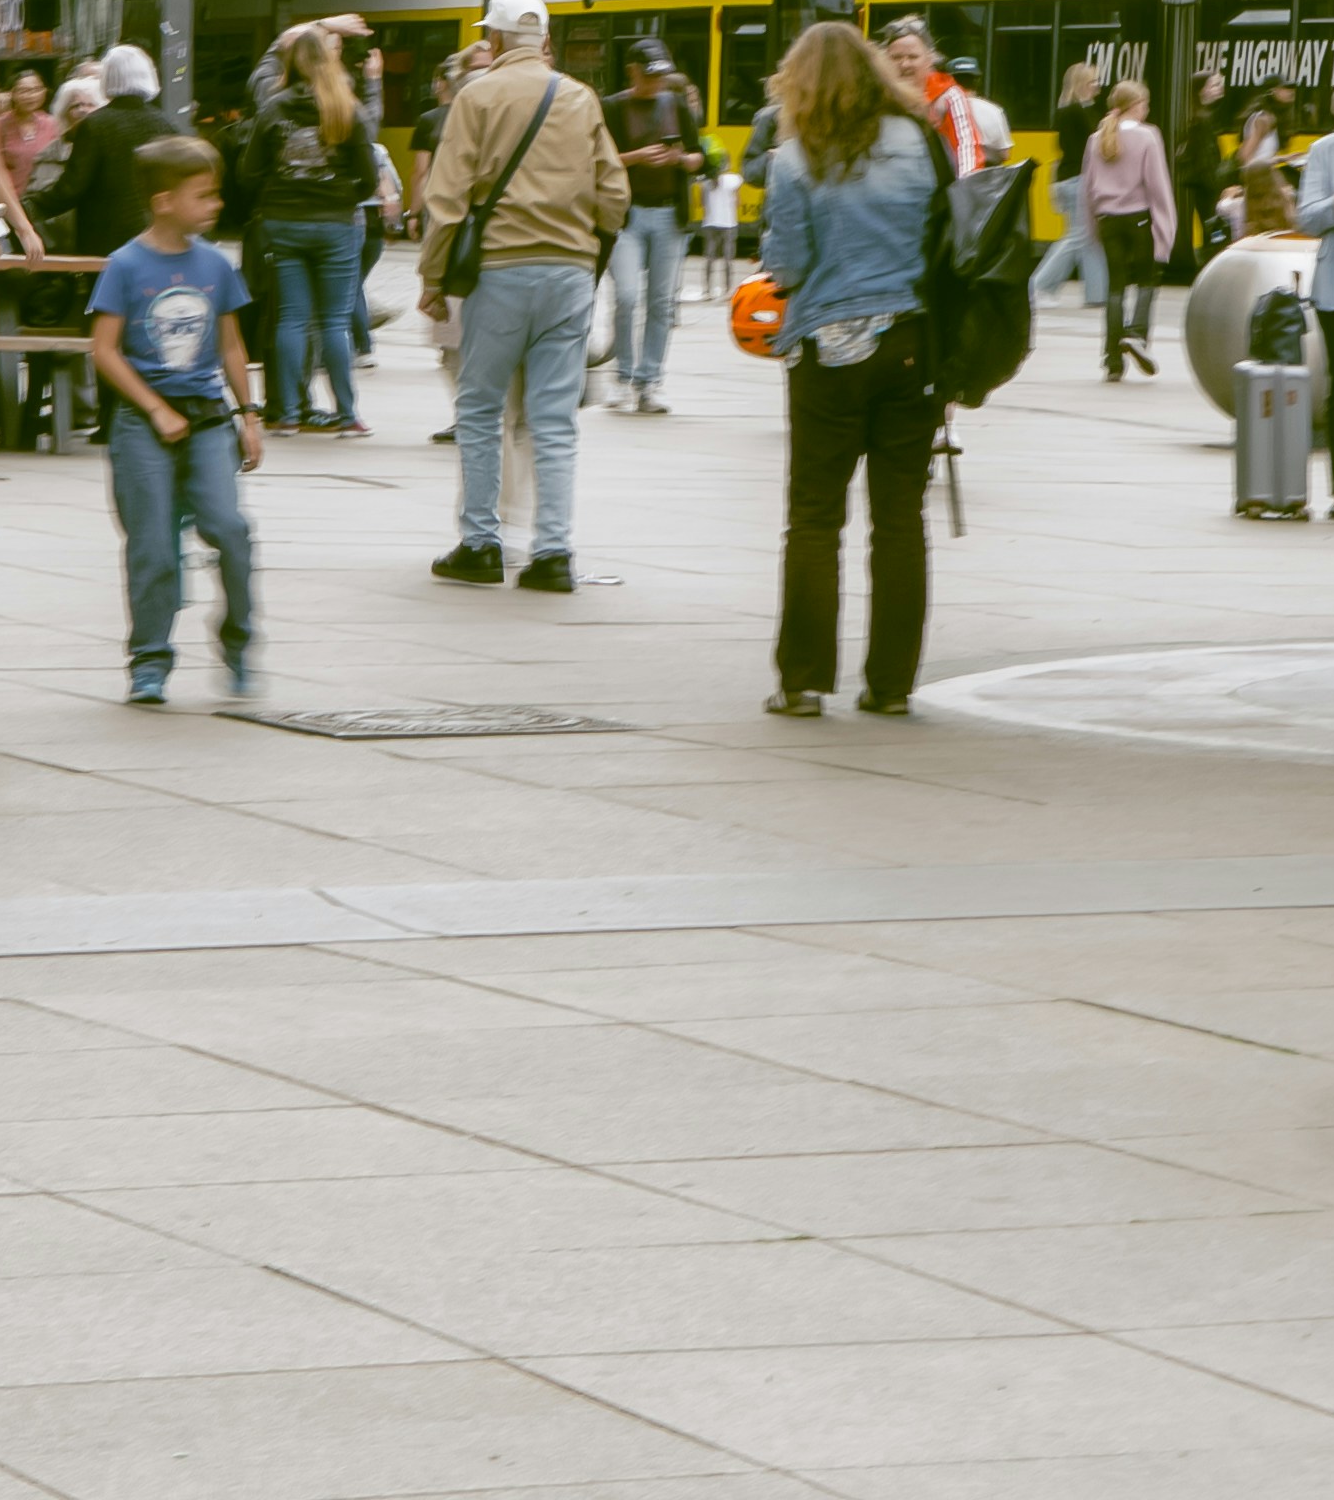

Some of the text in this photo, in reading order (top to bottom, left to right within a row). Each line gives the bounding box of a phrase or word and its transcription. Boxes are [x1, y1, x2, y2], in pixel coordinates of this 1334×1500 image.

[1117, 41, 1148, 84] ON
[1196, 40, 1229, 76] THE
[1230, 39, 1328, 88] HIGHWAY
